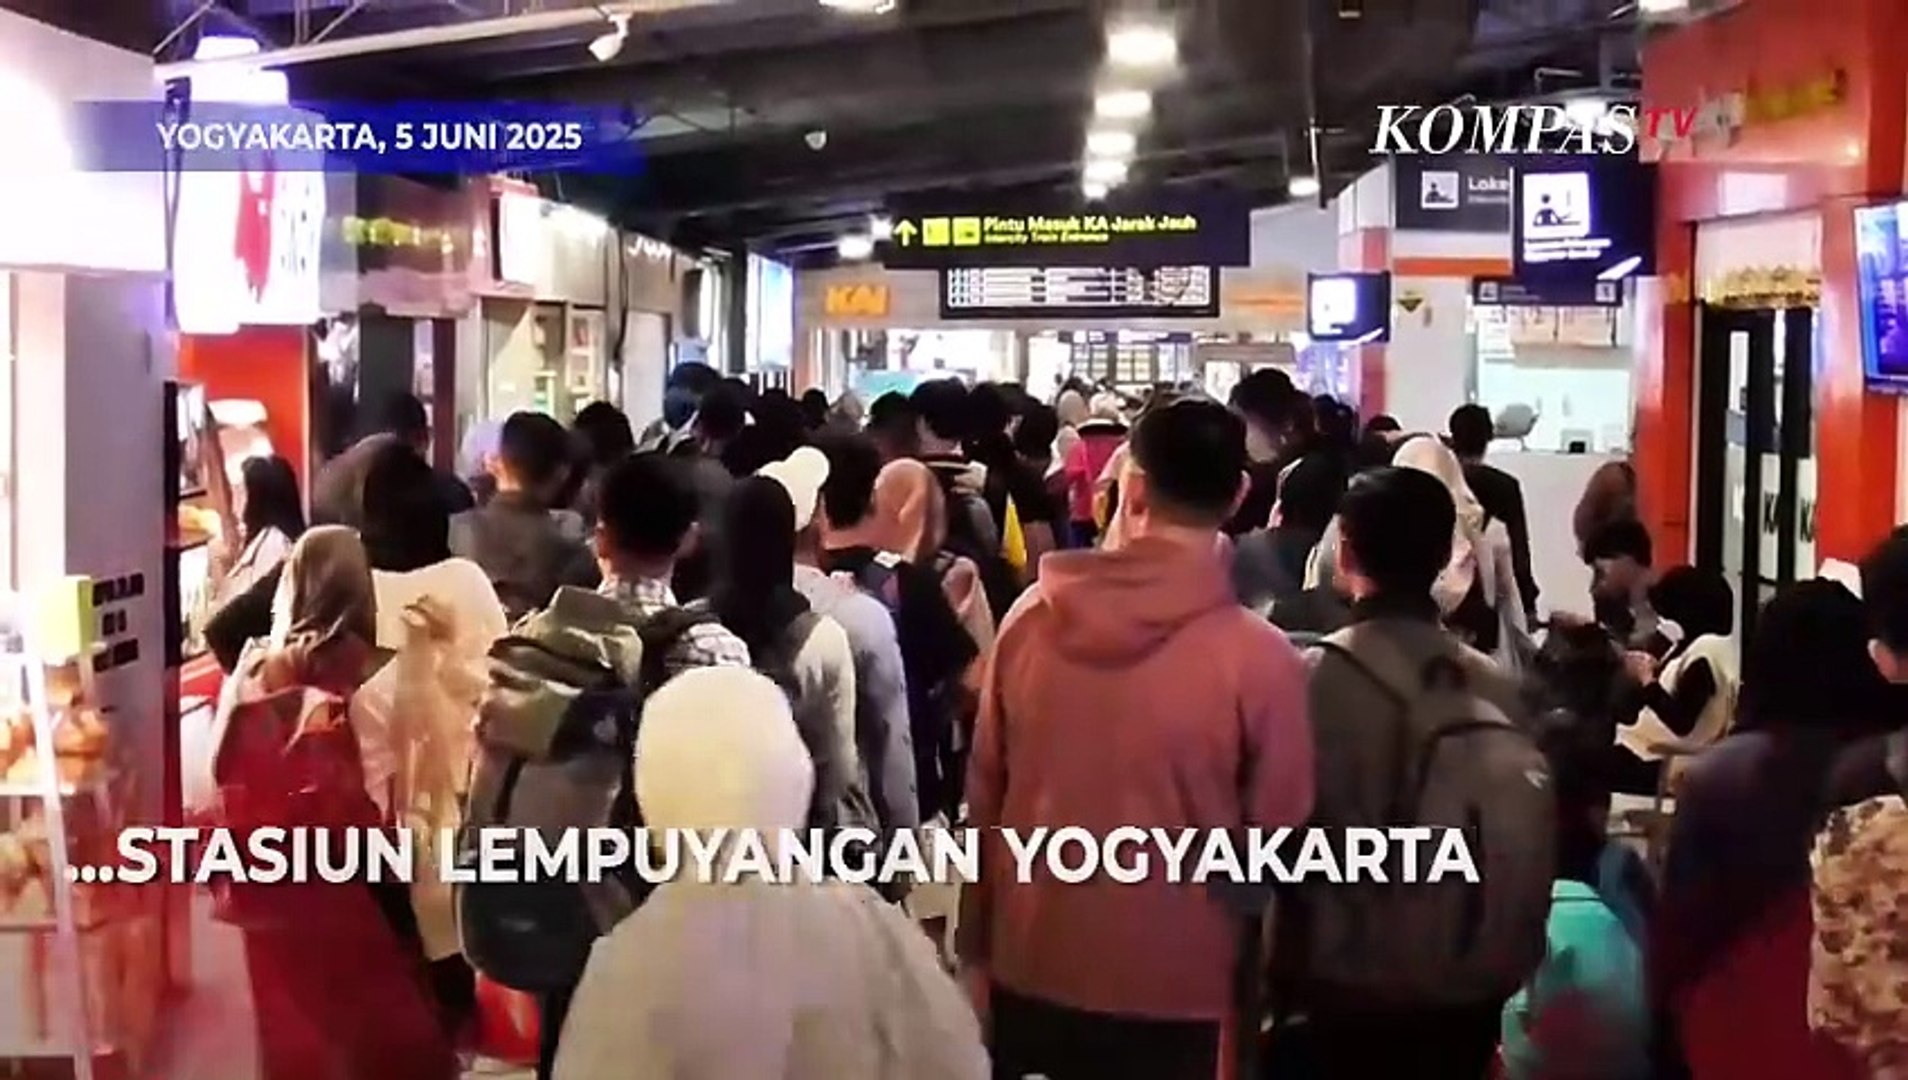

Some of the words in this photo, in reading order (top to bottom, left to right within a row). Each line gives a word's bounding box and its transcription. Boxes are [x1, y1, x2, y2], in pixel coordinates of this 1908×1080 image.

[983, 216, 1025, 232] Pintu
[1028, 216, 1080, 232] Masuk
[1083, 216, 1108, 231] KA
[1111, 216, 1155, 231] Jarak
[1158, 214, 1197, 230] Jauh
